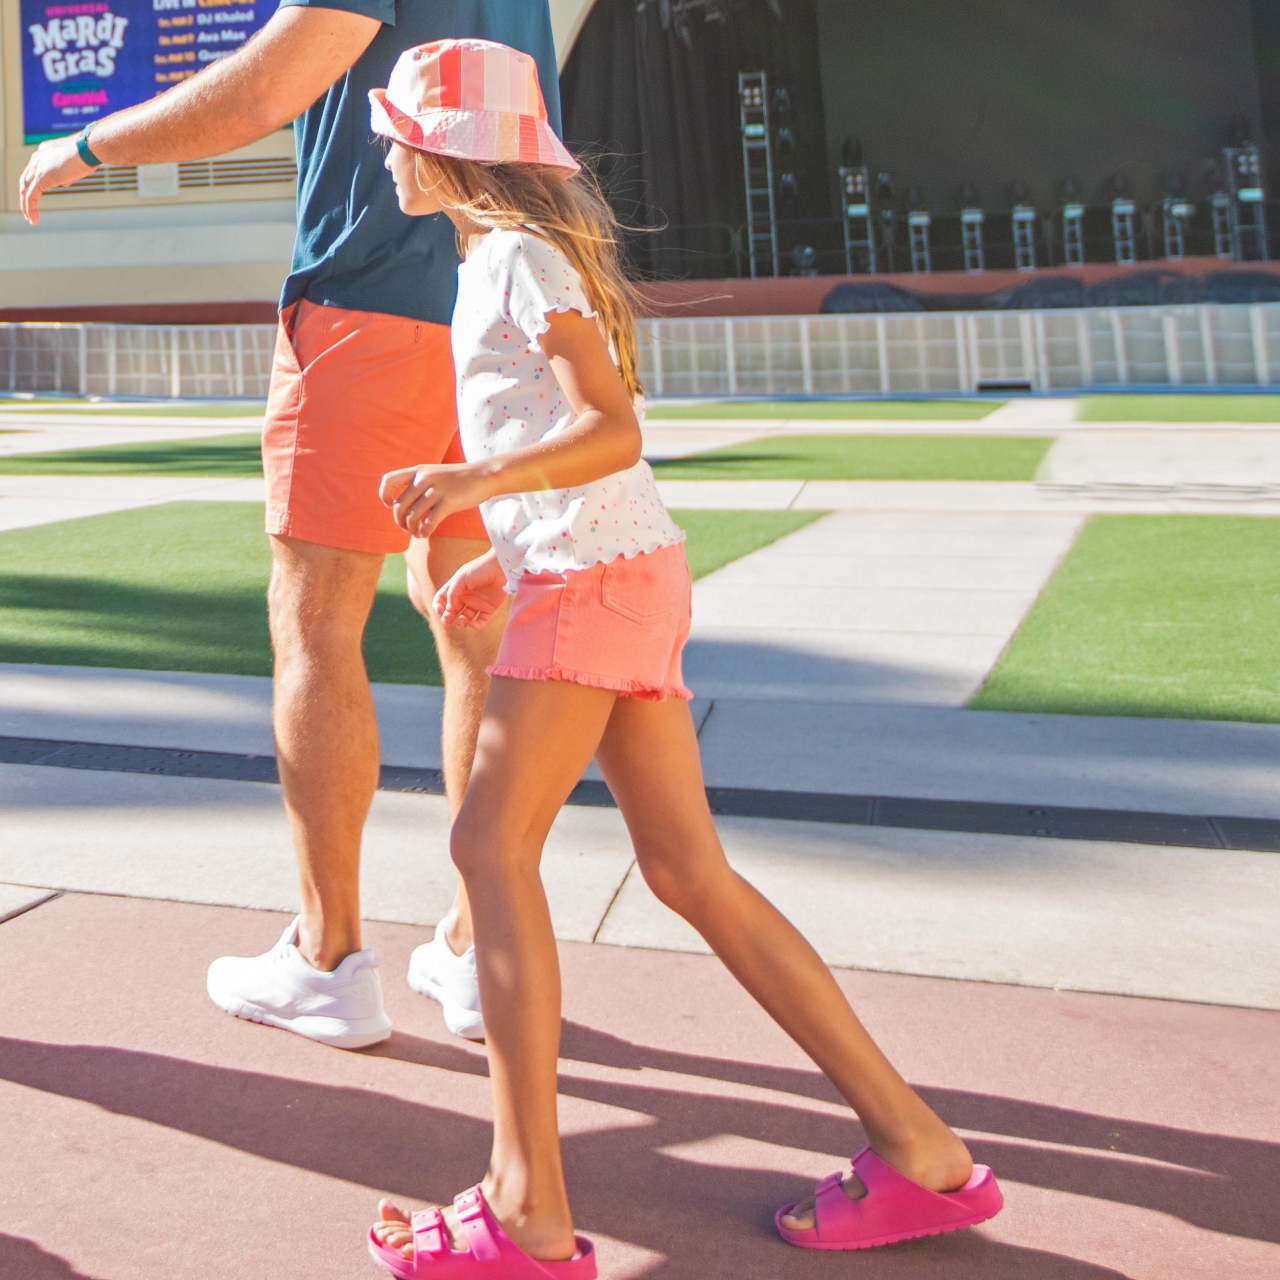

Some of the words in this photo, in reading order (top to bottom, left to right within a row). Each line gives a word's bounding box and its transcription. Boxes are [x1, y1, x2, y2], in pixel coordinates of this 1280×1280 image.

[46, 4, 110, 16] UNIVERSAL
[197, 13, 212, 25] DJ
[215, 9, 254, 23] Khaled
[197, 30, 220, 43] Ava
[220, 28, 246, 42] Max
